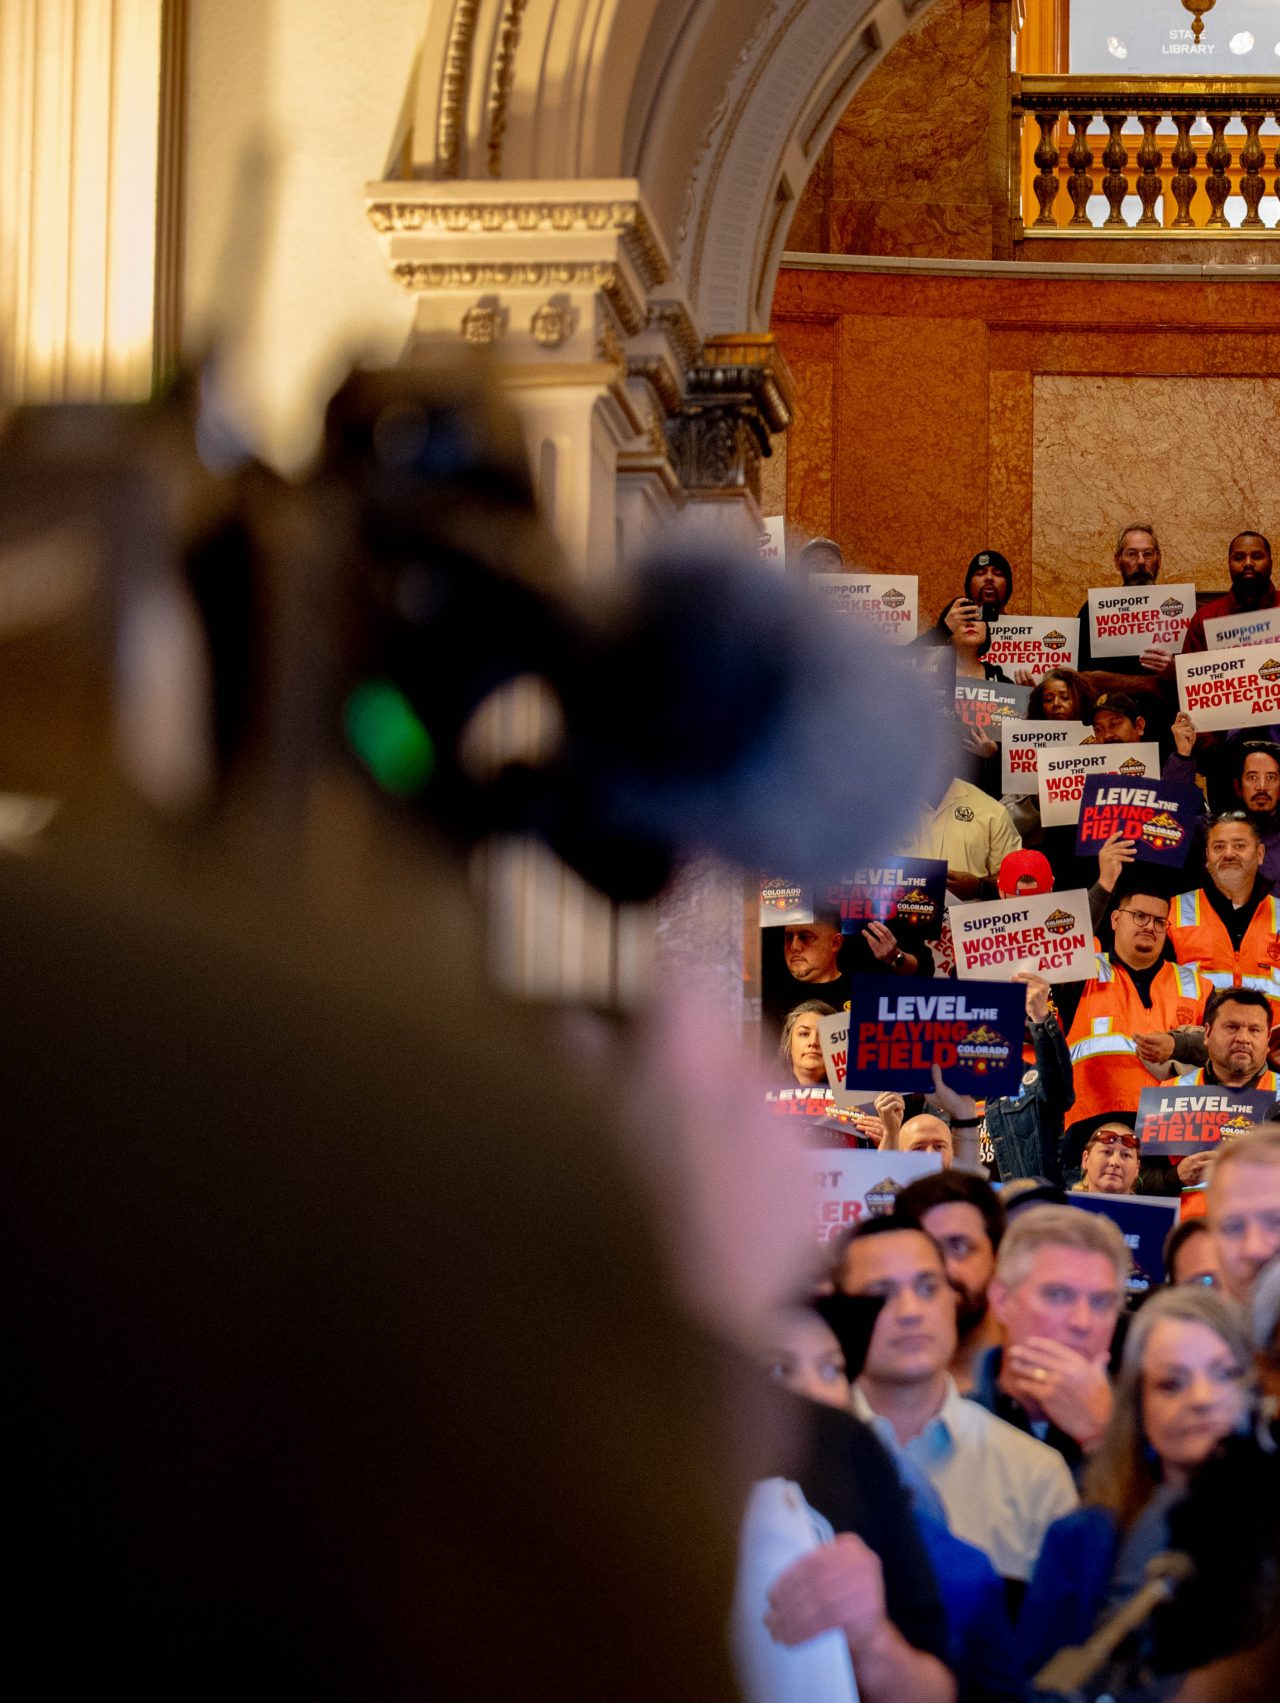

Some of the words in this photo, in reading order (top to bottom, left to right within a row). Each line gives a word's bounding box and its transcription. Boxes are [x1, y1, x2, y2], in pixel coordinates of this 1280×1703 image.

[1169, 29, 1207, 40] STAE
[1162, 44, 1215, 55] LIBRARY
[1098, 596, 1150, 610] SUPPORT
[1096, 610, 1160, 627] WORKER
[990, 626, 1033, 635] UPPORT
[1098, 617, 1191, 638] PROTECTION
[1216, 621, 1271, 642] SUPPORT
[1152, 631, 1181, 644] ACT
[1239, 635, 1251, 643] THE
[991, 641, 1042, 652] ORKER
[1031, 664, 1061, 675] AC
[1187, 659, 1246, 678] SUPPORT
[1210, 673, 1224, 681] THE
[1185, 674, 1259, 698] WORKER
[955, 686, 1000, 703] EVEL
[999, 696, 1016, 705] THE
[955, 701, 998, 713] YING
[1012, 732, 1068, 743] SUPPORT
[1048, 756, 1107, 771] SUPPORT
[1046, 774, 1085, 792] WOR
[1095, 787, 1159, 807] LEVEL
[1156, 799, 1179, 812] THE
[1083, 805, 1156, 822] PLAYING
[1142, 824, 1182, 838] COLORADO
[906, 877, 927, 887] THE
[762, 888, 801, 896] COLORADO
[840, 898, 898, 921] IELD
[896, 903, 934, 912] COLORADO
[963, 910, 1030, 932] SUPPORT
[1045, 917, 1074, 926] COLORADO
[990, 926, 1006, 935] THE
[962, 926, 1046, 955] WORKER
[966, 934, 1086, 970] PROTECTION
[1038, 952, 1074, 972] ACT
[878, 996, 973, 1022] LEVEL
[971, 1008, 999, 1021] THE
[859, 1022, 969, 1042] PLAYING
[857, 1042, 959, 1070] FIELD
[956, 1045, 1010, 1055] COLORADO
[1160, 1096, 1233, 1113] LEVEL
[1231, 1104, 1253, 1114] THE
[1144, 1112, 1230, 1125] PLAYING
[1142, 1124, 1221, 1143] FIELD
[1220, 1127, 1246, 1136] COLOR
